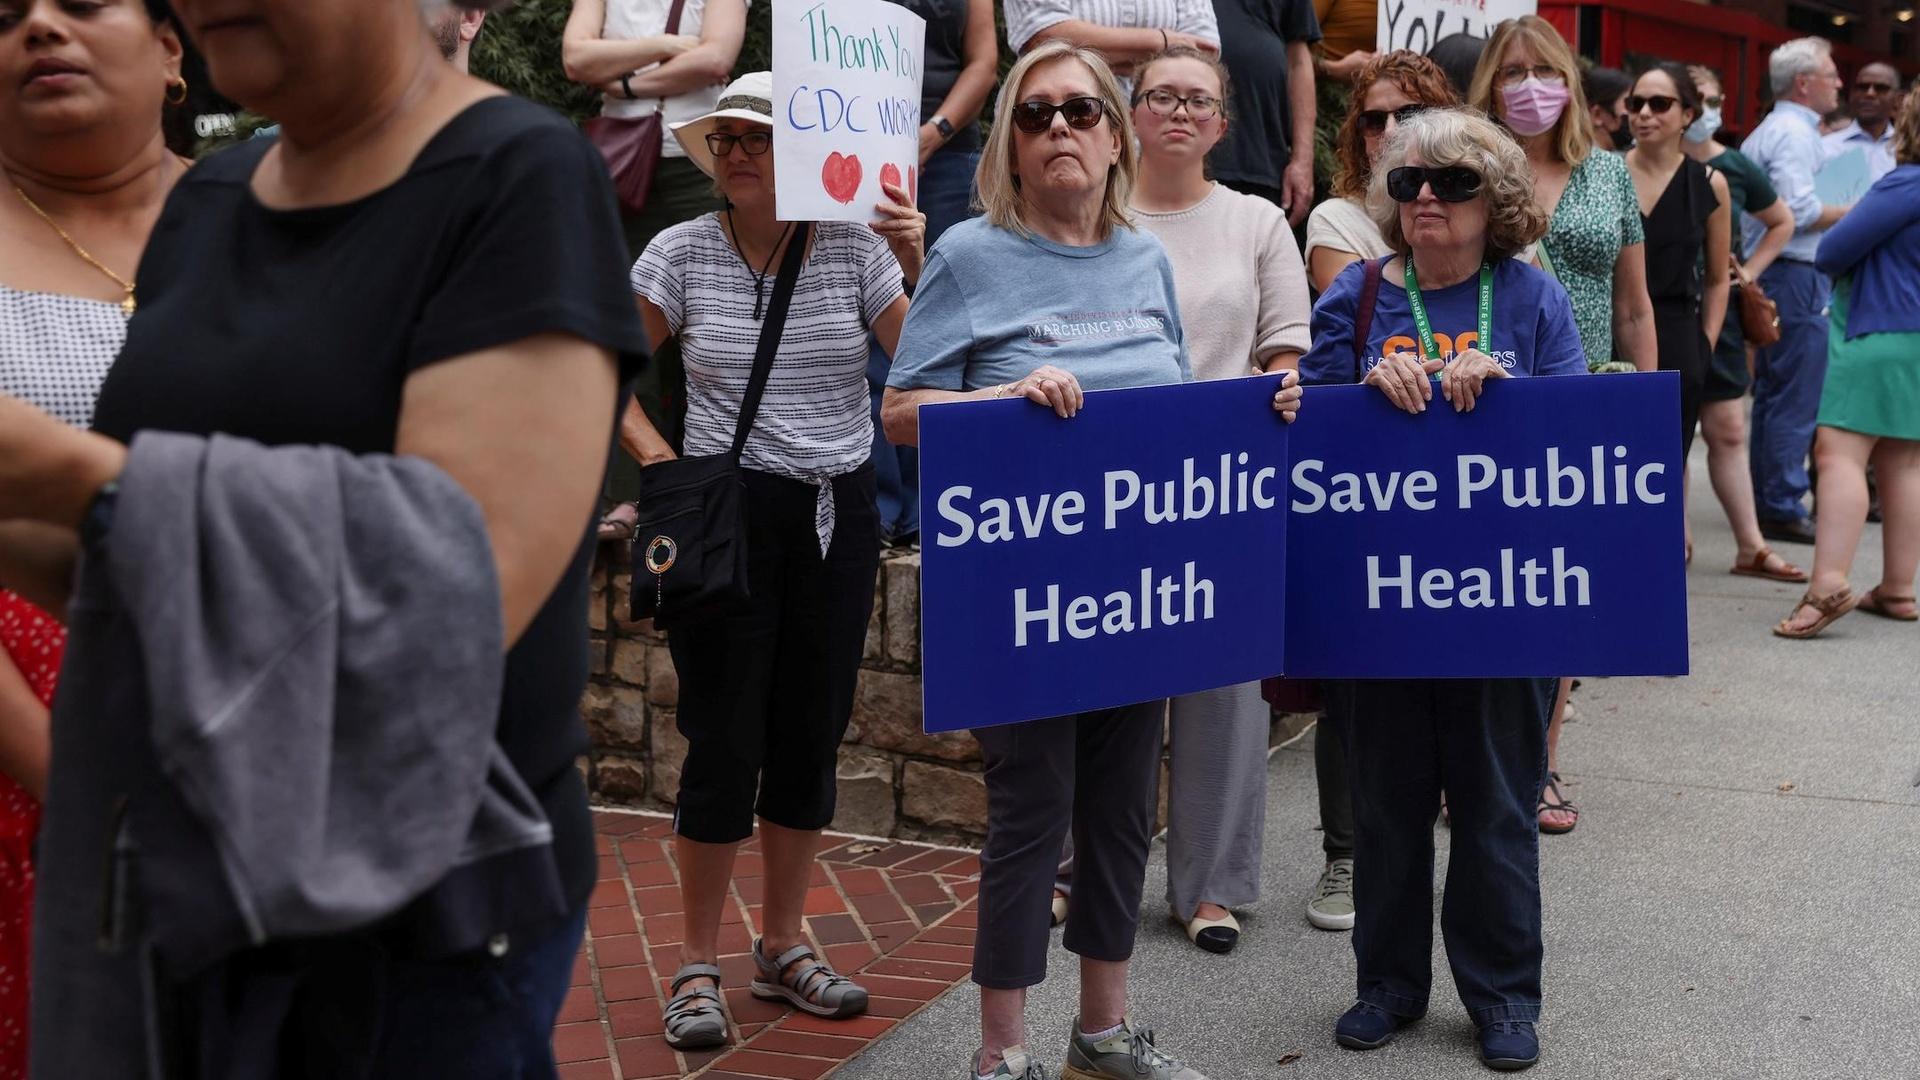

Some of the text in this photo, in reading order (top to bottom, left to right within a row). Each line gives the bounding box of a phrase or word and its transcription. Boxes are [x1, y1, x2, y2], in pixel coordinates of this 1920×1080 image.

[800, 2, 889, 73] Thank
[788, 85, 868, 133] CDC
[1409, 290, 1424, 320] PERSIST
[1481, 285, 1489, 311] RESIST
[1026, 321, 1111, 340] MARCHING
[1420, 328, 1435, 353] RESIST
[1480, 320, 1488, 352] PERSIST
[936, 451, 1276, 548] Save Public
[1291, 445, 1666, 514] Save Public
[1366, 546, 1591, 609] Health
[1013, 560, 1215, 648] Health
